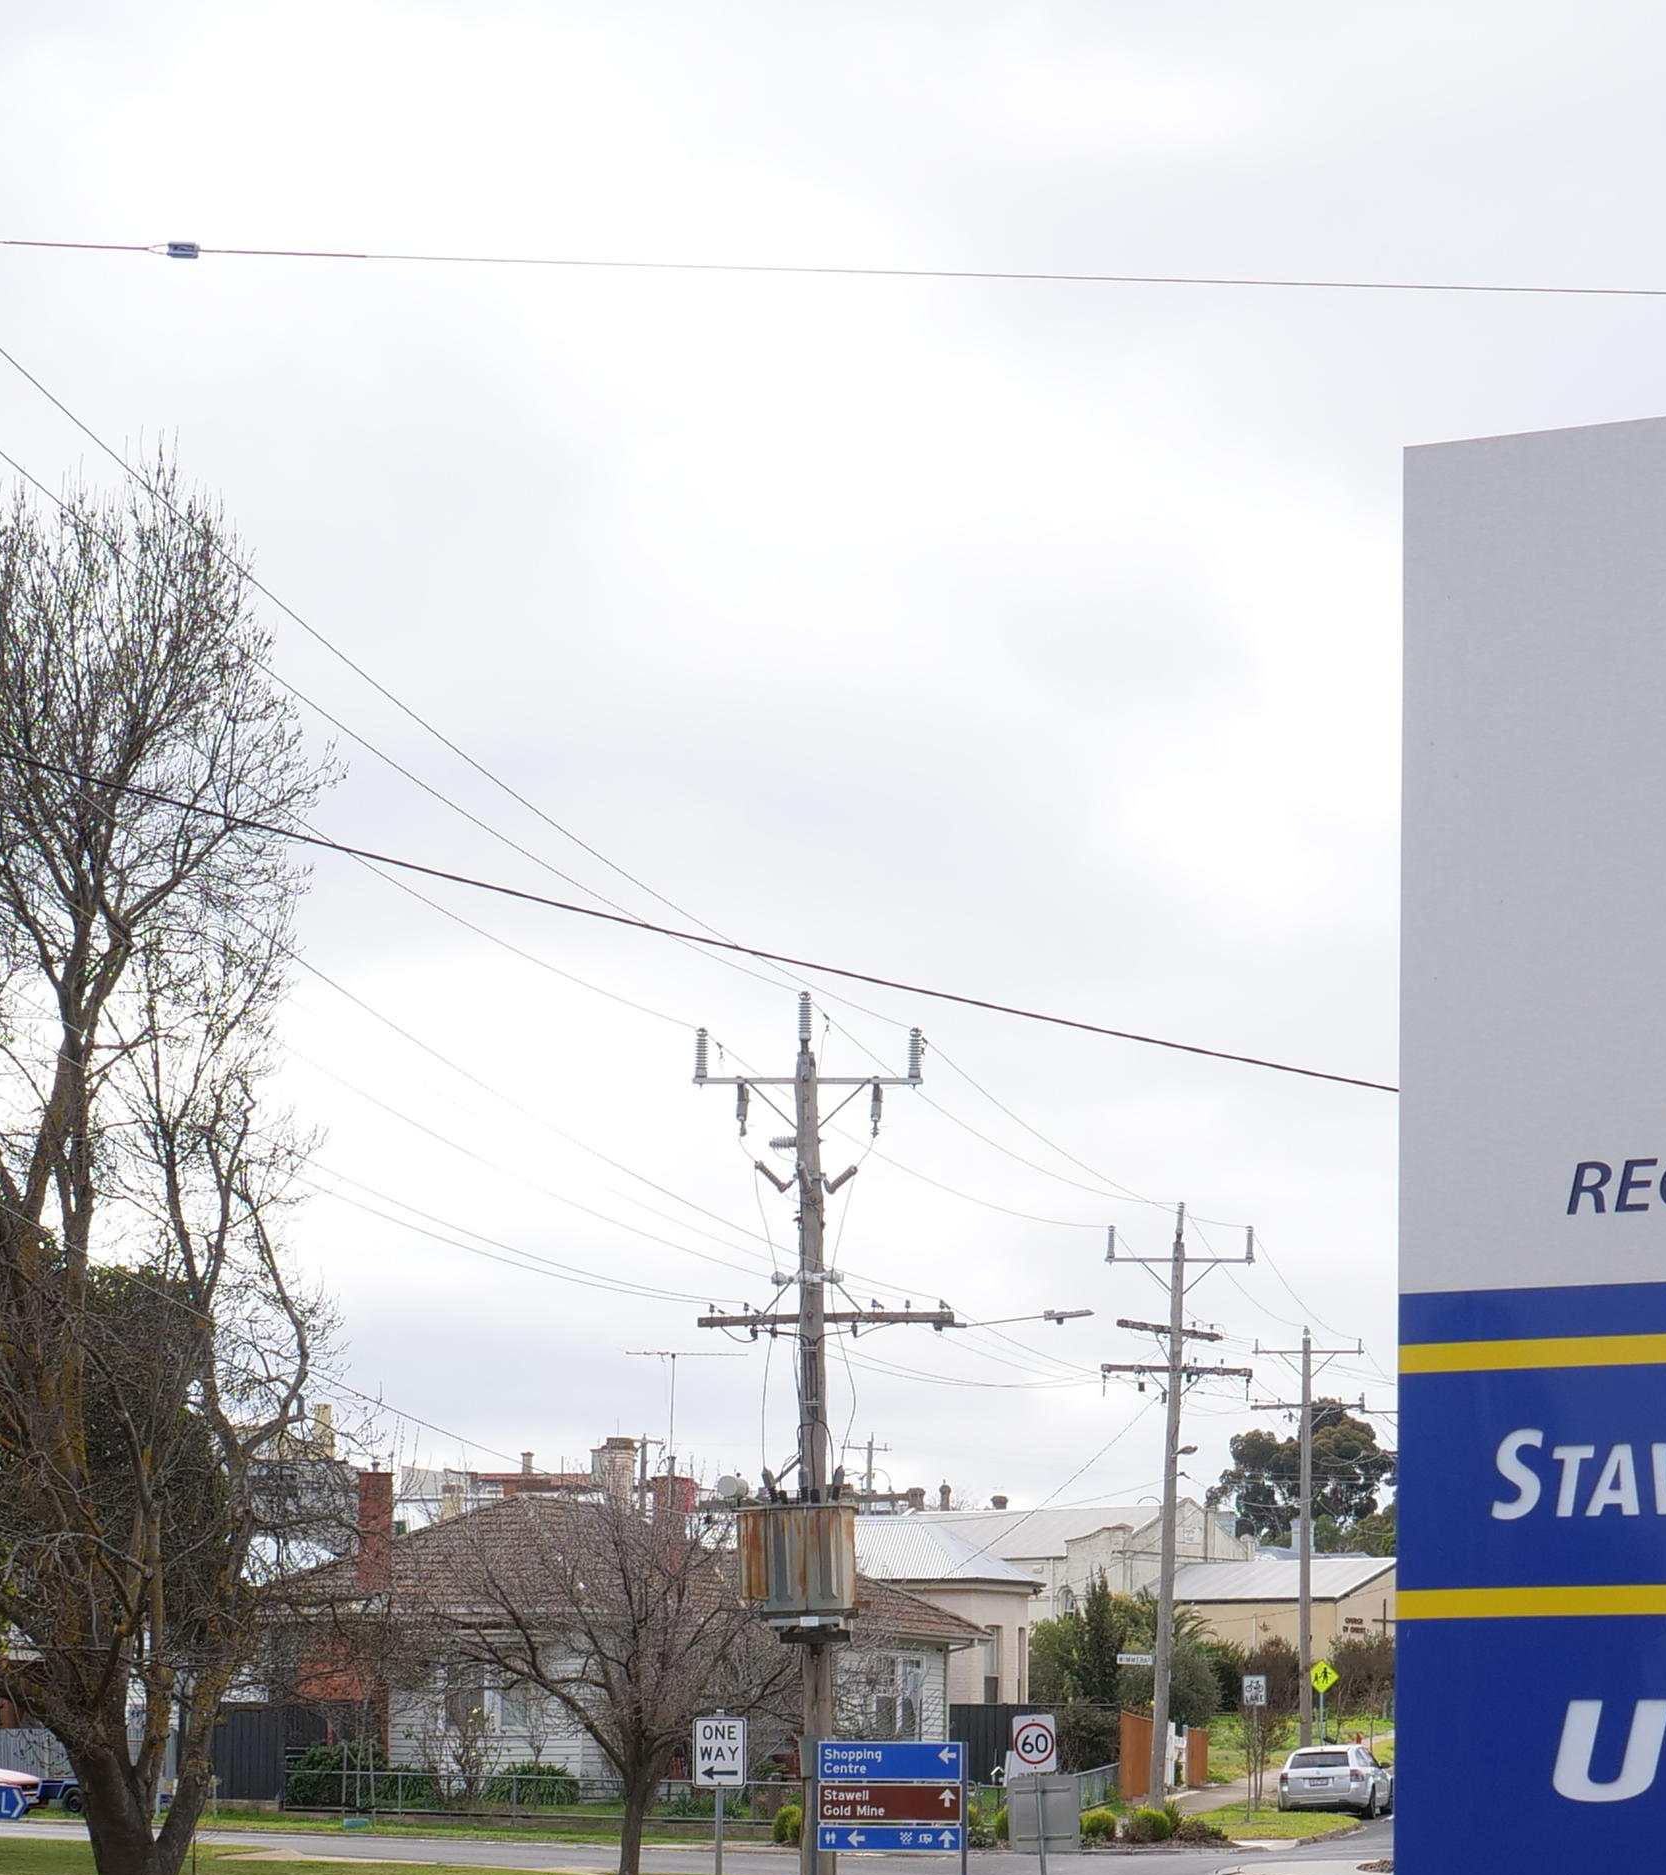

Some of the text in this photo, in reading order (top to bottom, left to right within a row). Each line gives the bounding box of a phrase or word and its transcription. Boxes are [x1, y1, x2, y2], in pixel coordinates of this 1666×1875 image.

[702, 1725, 737, 1741] ONE
[1021, 1733, 1049, 1754] 60
[700, 1746, 739, 1761] WAY
[824, 1748, 883, 1763] Shopping
[823, 1762, 868, 1774] Centre
[823, 1789, 870, 1801] Stawell
[823, 1805, 886, 1817] Gold Mine
